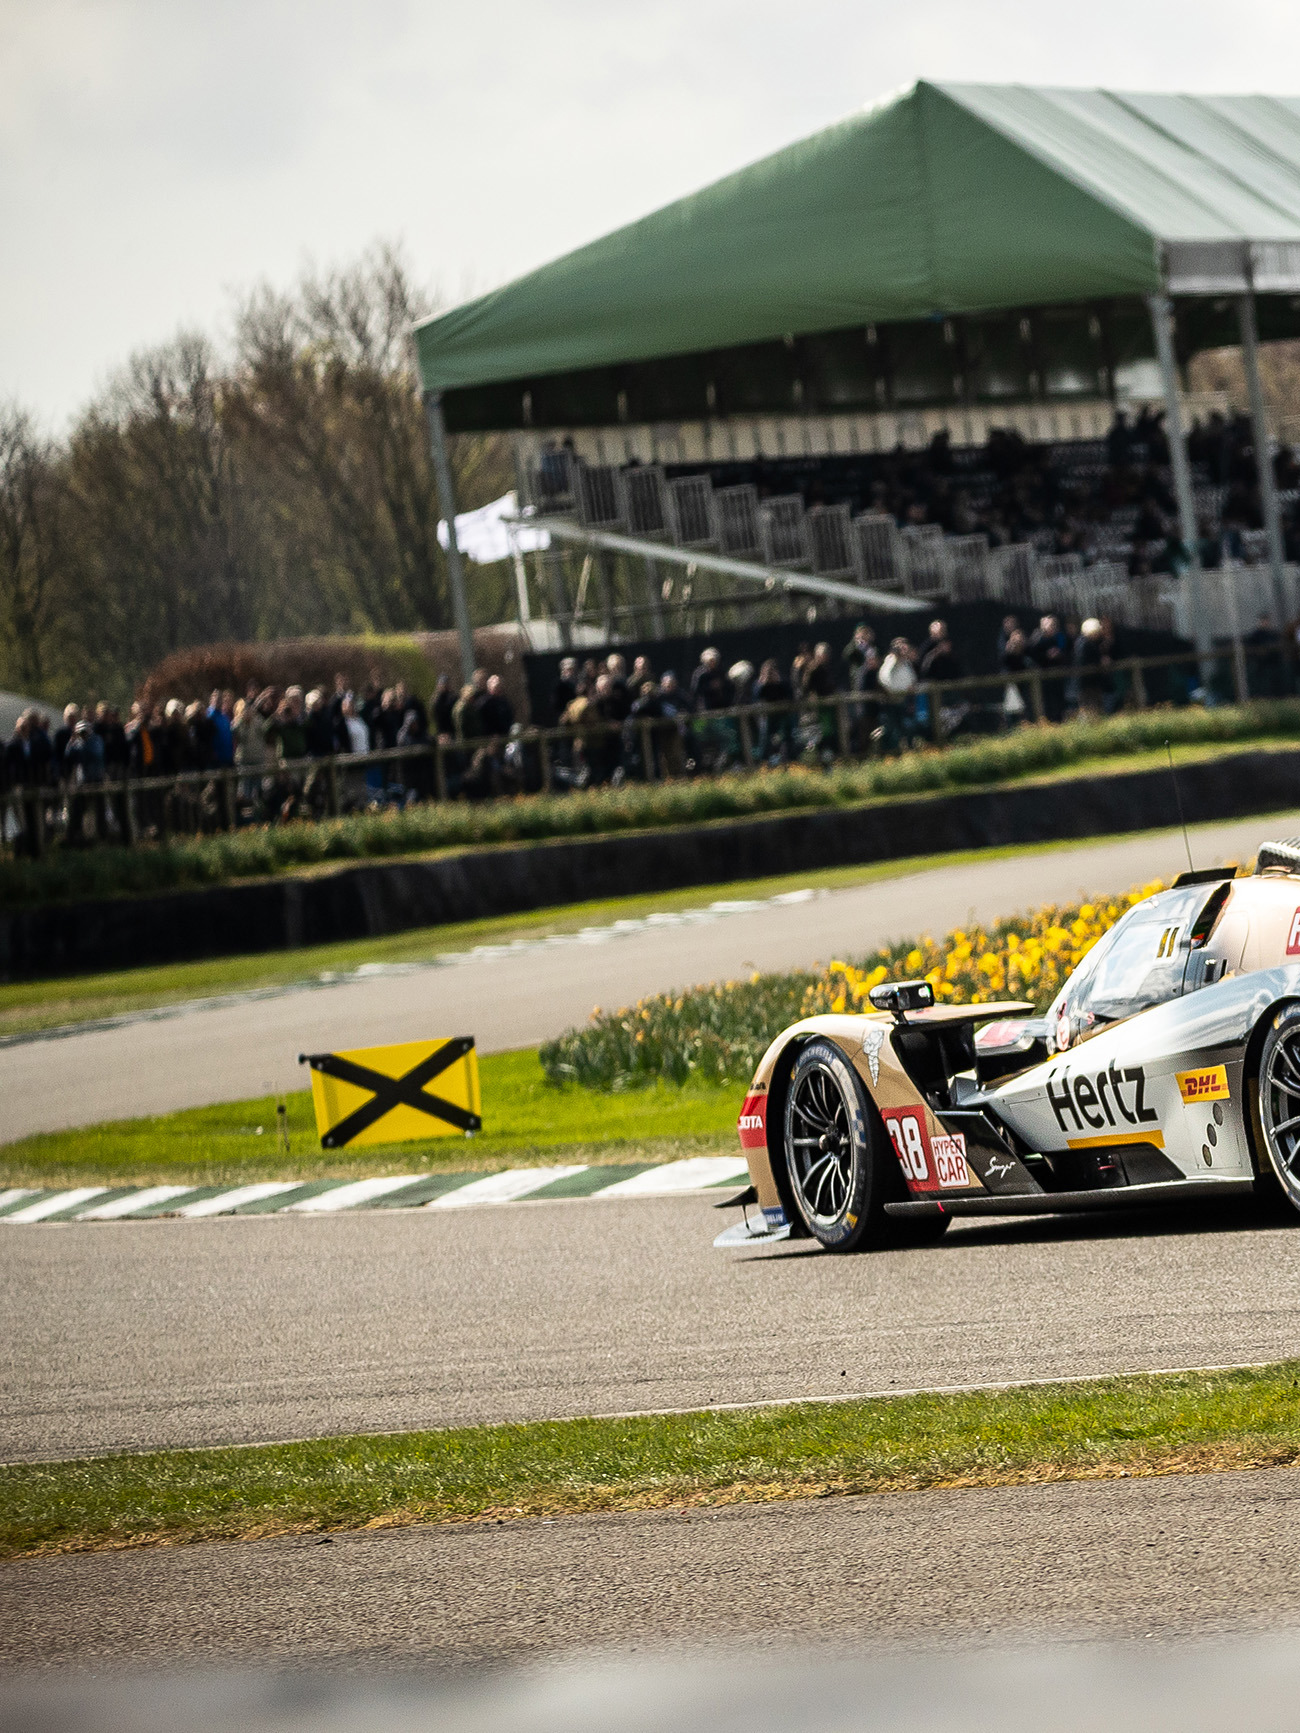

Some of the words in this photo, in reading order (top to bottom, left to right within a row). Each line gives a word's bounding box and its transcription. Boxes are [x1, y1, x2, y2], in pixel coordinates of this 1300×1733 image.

[1045, 1058, 1158, 1132] Hertz
[1184, 1073, 1221, 1096] DHL
[886, 1116, 929, 1180] 38
[932, 1138, 963, 1157] HYPER
[936, 1156, 968, 1182] CAR
